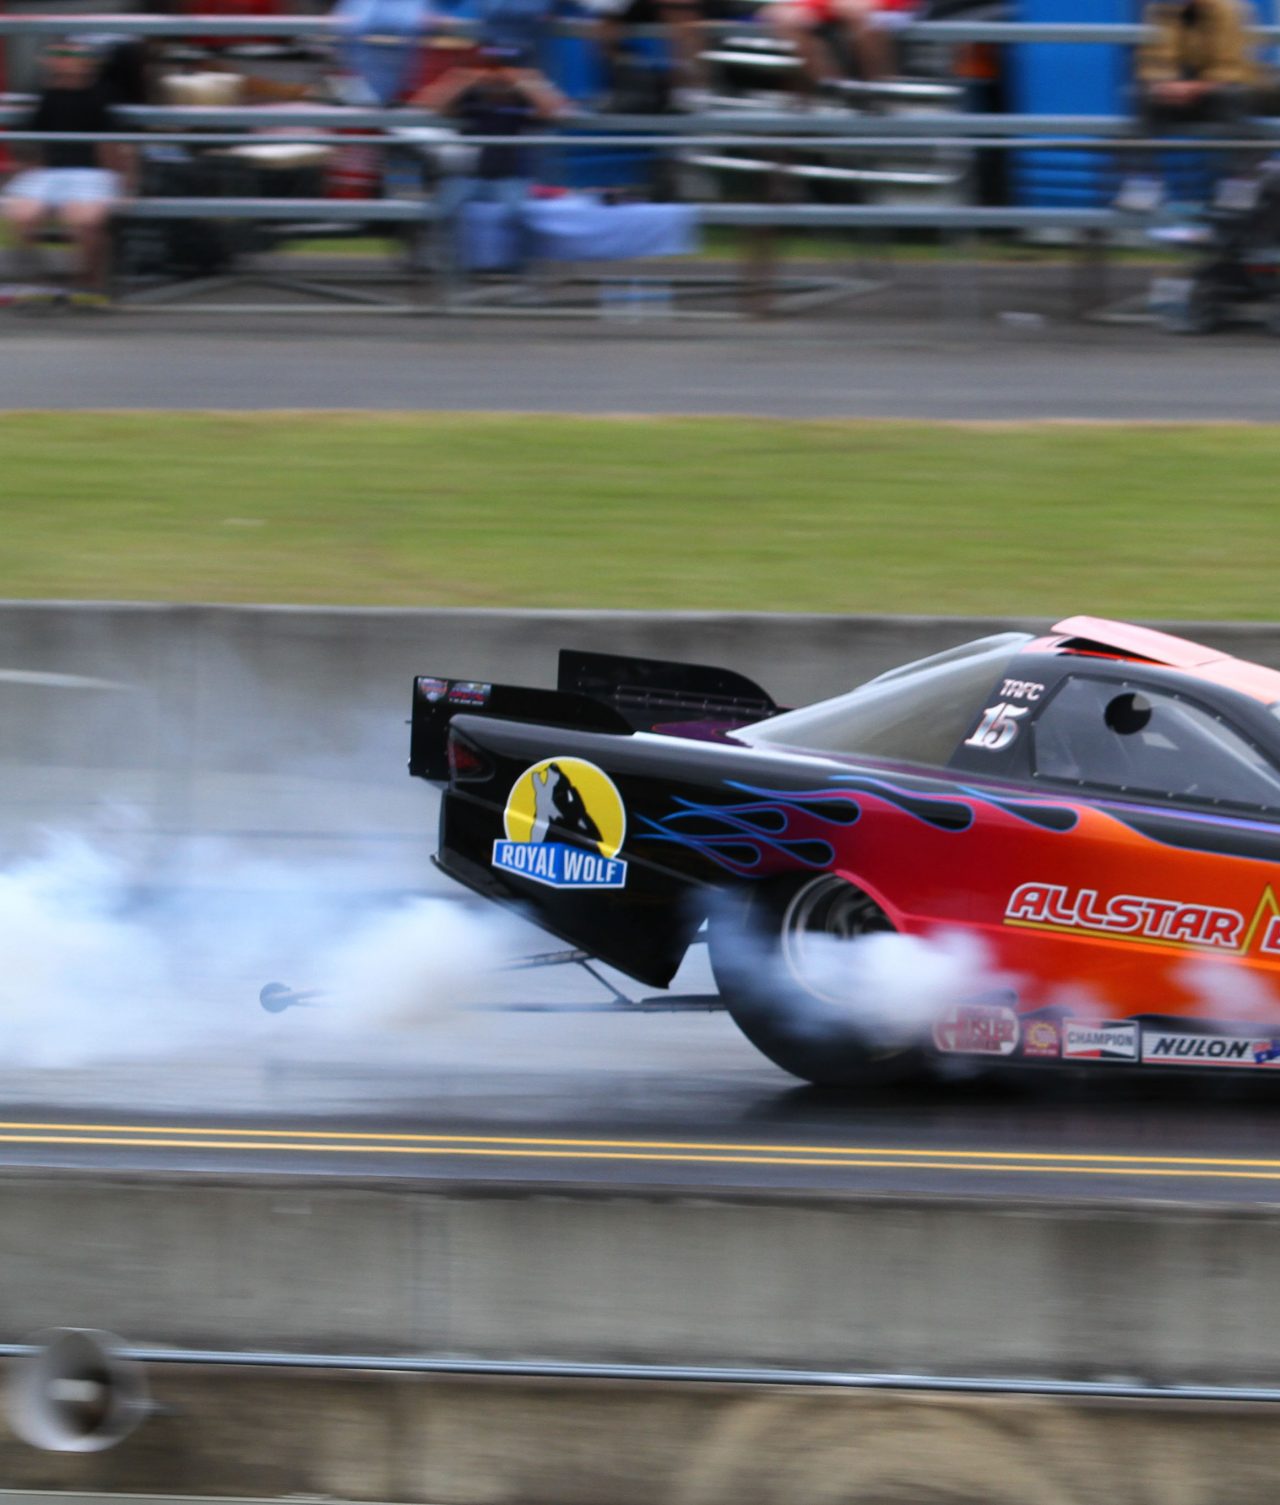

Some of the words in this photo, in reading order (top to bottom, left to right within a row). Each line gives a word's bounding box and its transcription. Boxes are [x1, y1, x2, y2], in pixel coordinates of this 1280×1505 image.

[1000, 679, 1045, 700] TAFC
[964, 702, 1029, 750] 15
[501, 844, 556, 879] ROYAL
[563, 849, 617, 883] WOLF
[1005, 881, 1244, 948] ALLSTAR
[1068, 1030, 1134, 1047] CHAMPION
[1152, 1037, 1250, 1059] NULON
